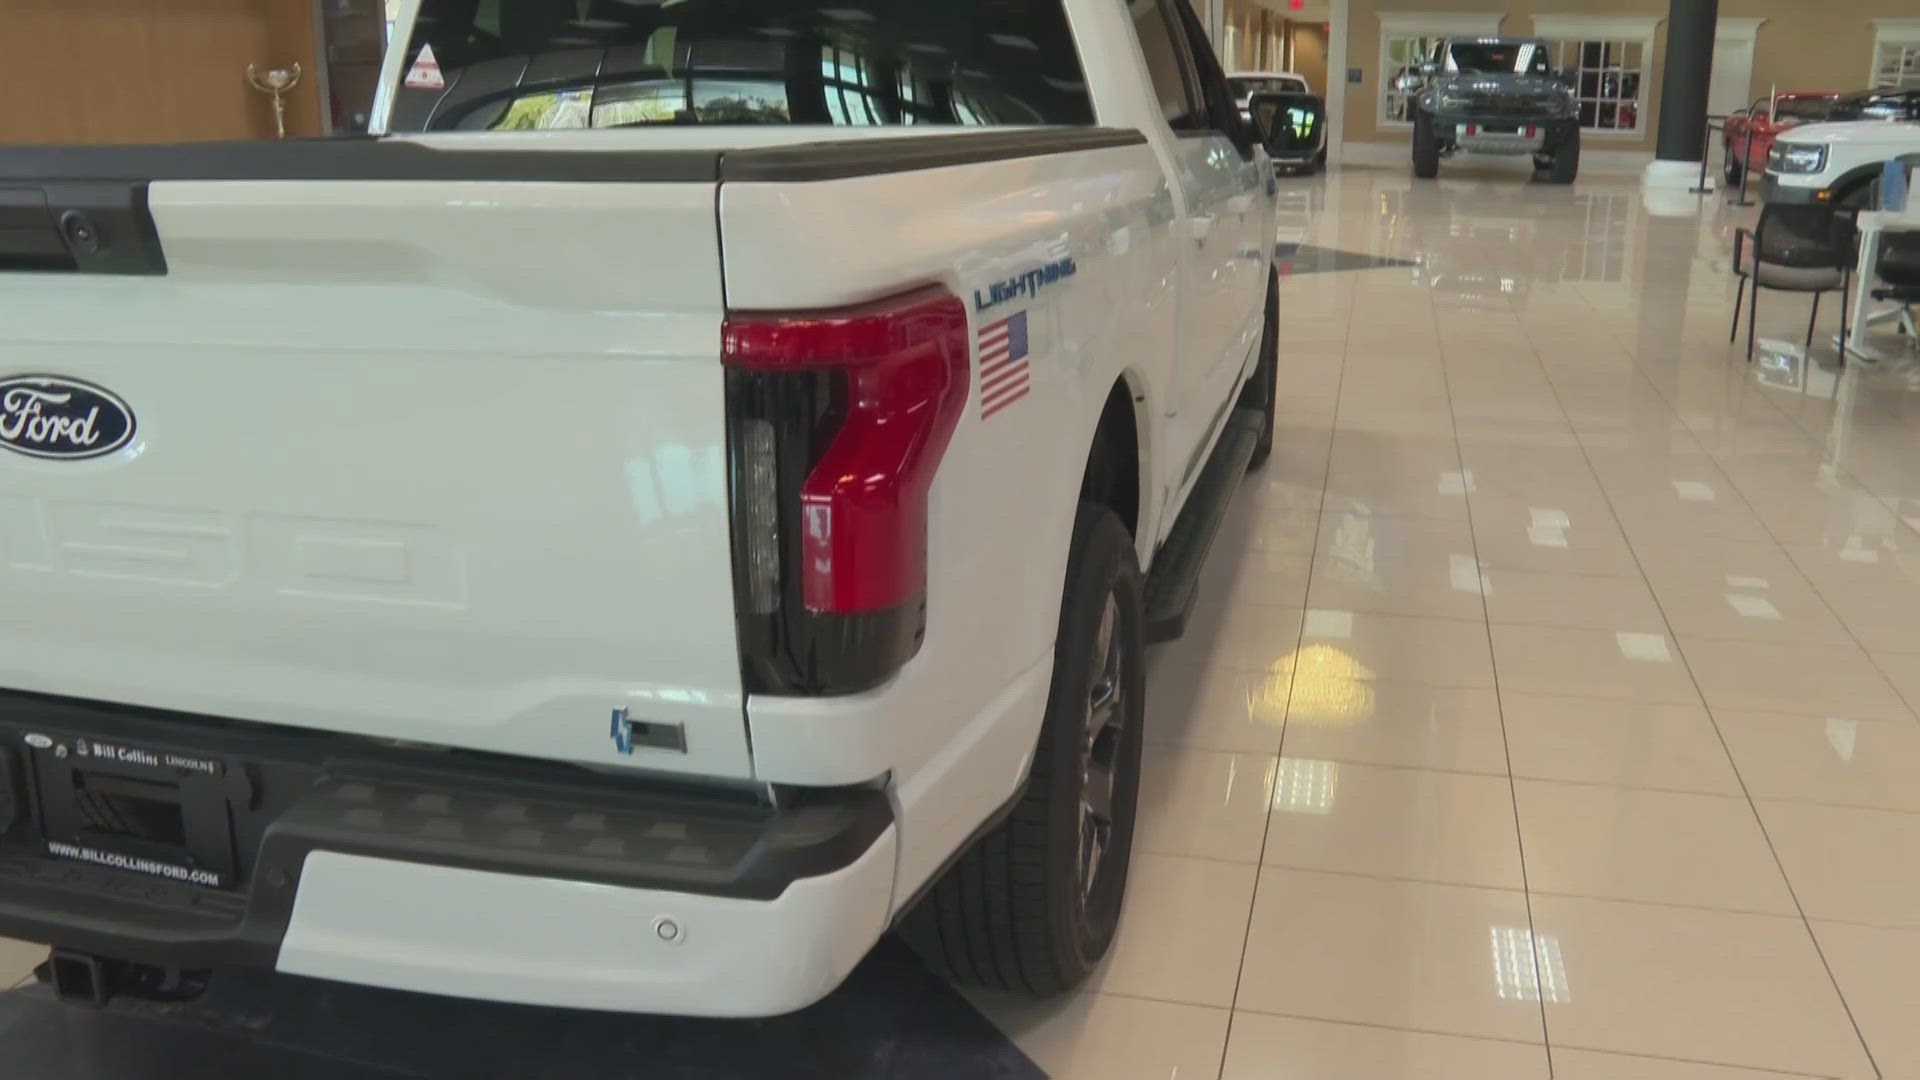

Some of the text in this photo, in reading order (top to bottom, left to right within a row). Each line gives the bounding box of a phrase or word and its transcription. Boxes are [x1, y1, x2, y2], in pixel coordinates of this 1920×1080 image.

[974, 257, 1076, 314] LIGHTNING
[0, 387, 100, 446] Ford
[92, 742, 116, 760] Bill
[117, 748, 159, 766] Collins
[48, 841, 219, 887] WWW.BILLCOLLINSFORD.COM
